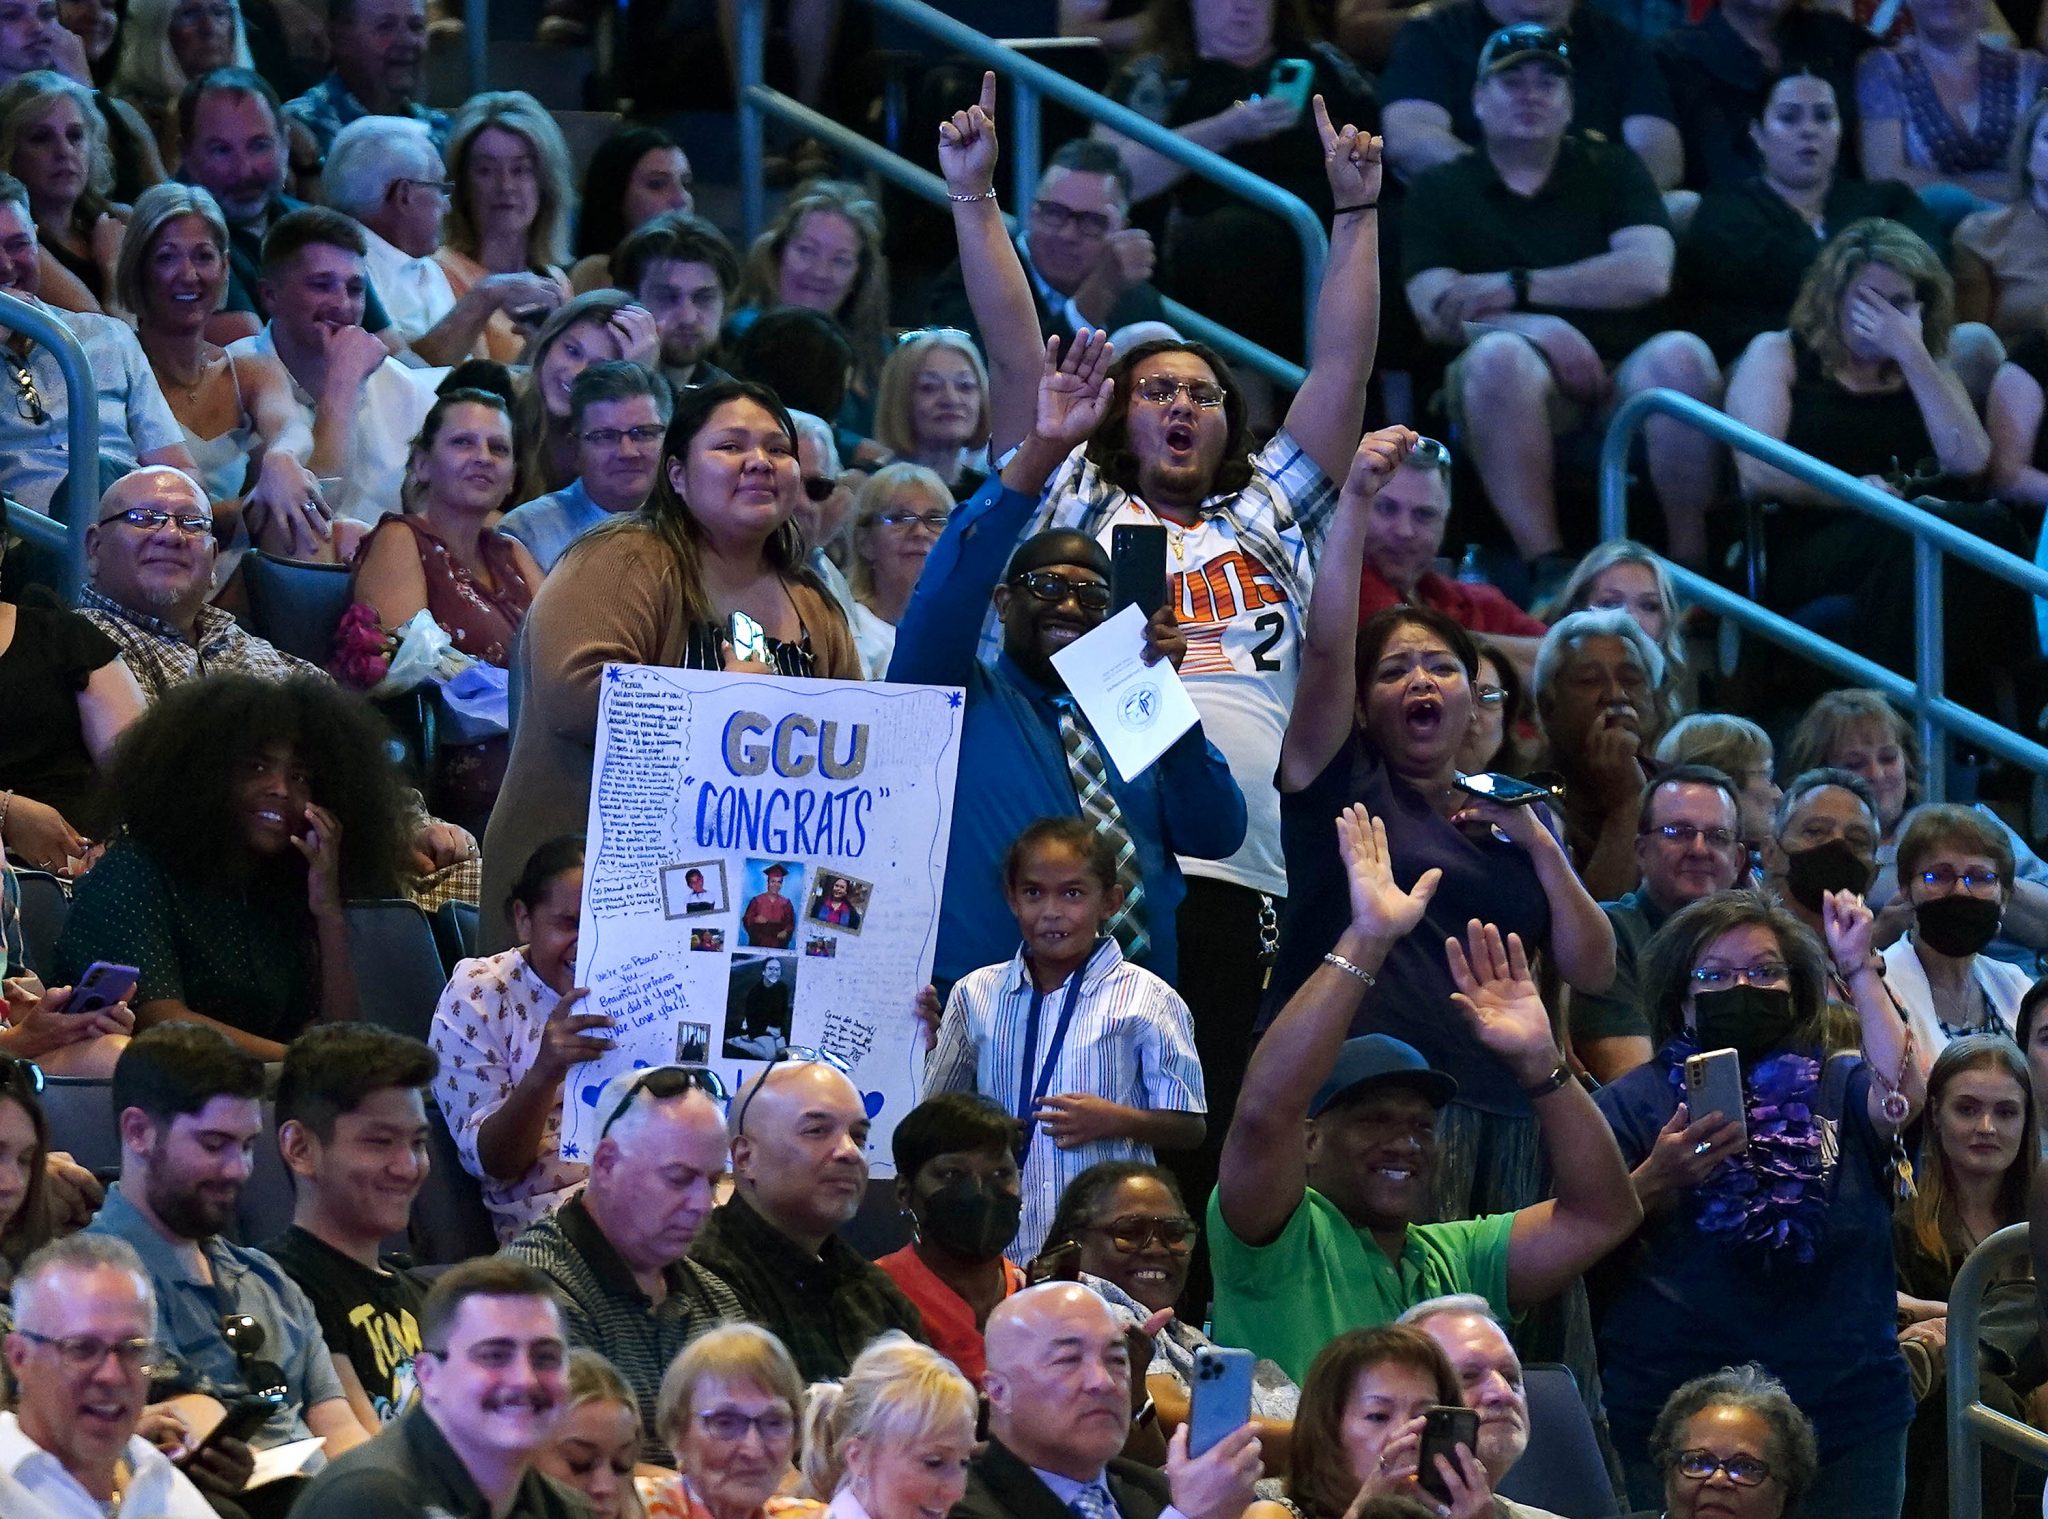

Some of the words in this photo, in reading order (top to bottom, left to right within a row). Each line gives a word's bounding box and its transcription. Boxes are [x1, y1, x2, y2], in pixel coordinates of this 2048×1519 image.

[1174, 551, 1288, 625] UNS
[1250, 611, 1284, 671] 2
[720, 709, 870, 780] GCU
[628, 998, 642, 1014] did
